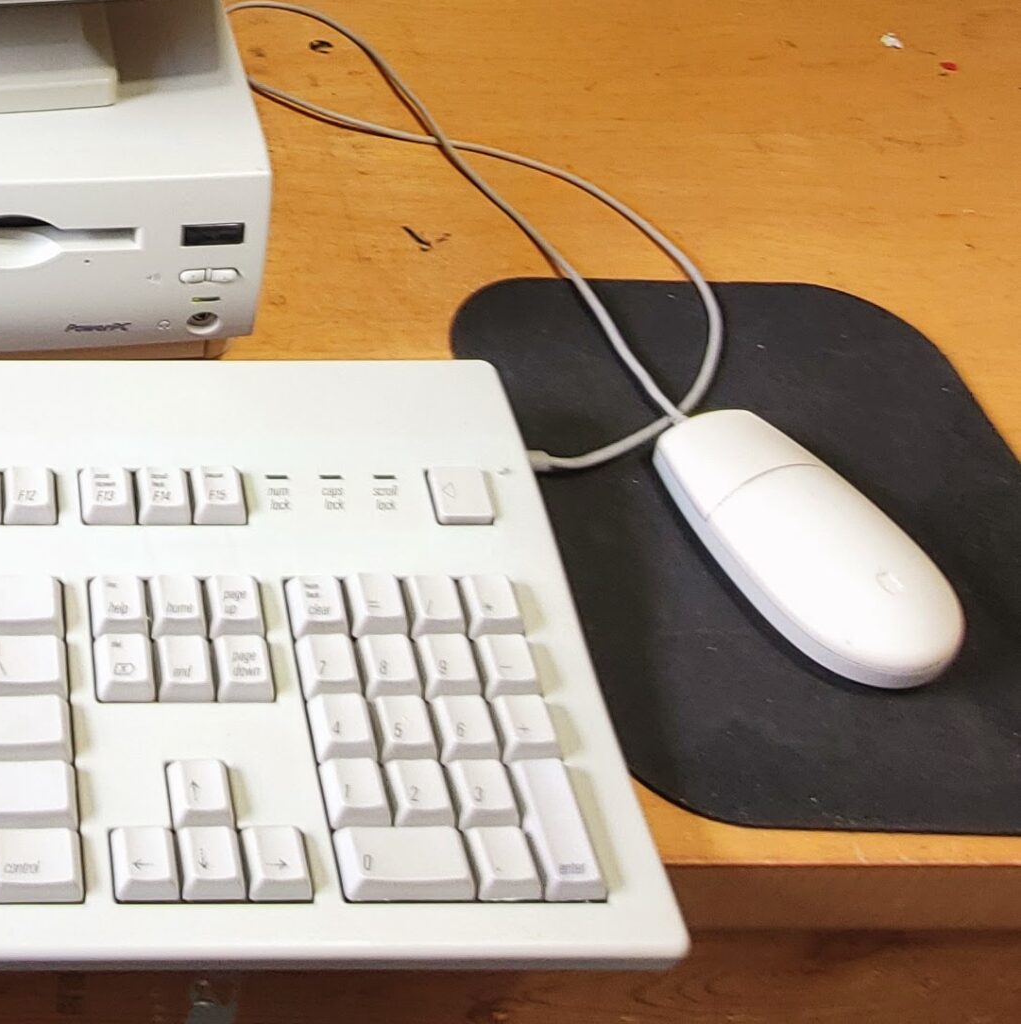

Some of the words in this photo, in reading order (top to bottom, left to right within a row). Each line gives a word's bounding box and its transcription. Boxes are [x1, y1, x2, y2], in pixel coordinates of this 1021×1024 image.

[65, 322, 131, 332] PowerPC
[17, 490, 37, 501] F12
[96, 490, 115, 502] F13
[152, 490, 170, 502] F14
[208, 490, 226, 501] F15
[270, 499, 291, 510] lock
[324, 499, 345, 510] lock
[376, 499, 397, 510] lock
[108, 603, 128, 615] help
[166, 603, 193, 614] home
[409, 785, 420, 802] 2
[4, 860, 41, 874] control
[559, 862, 586, 874] enter
